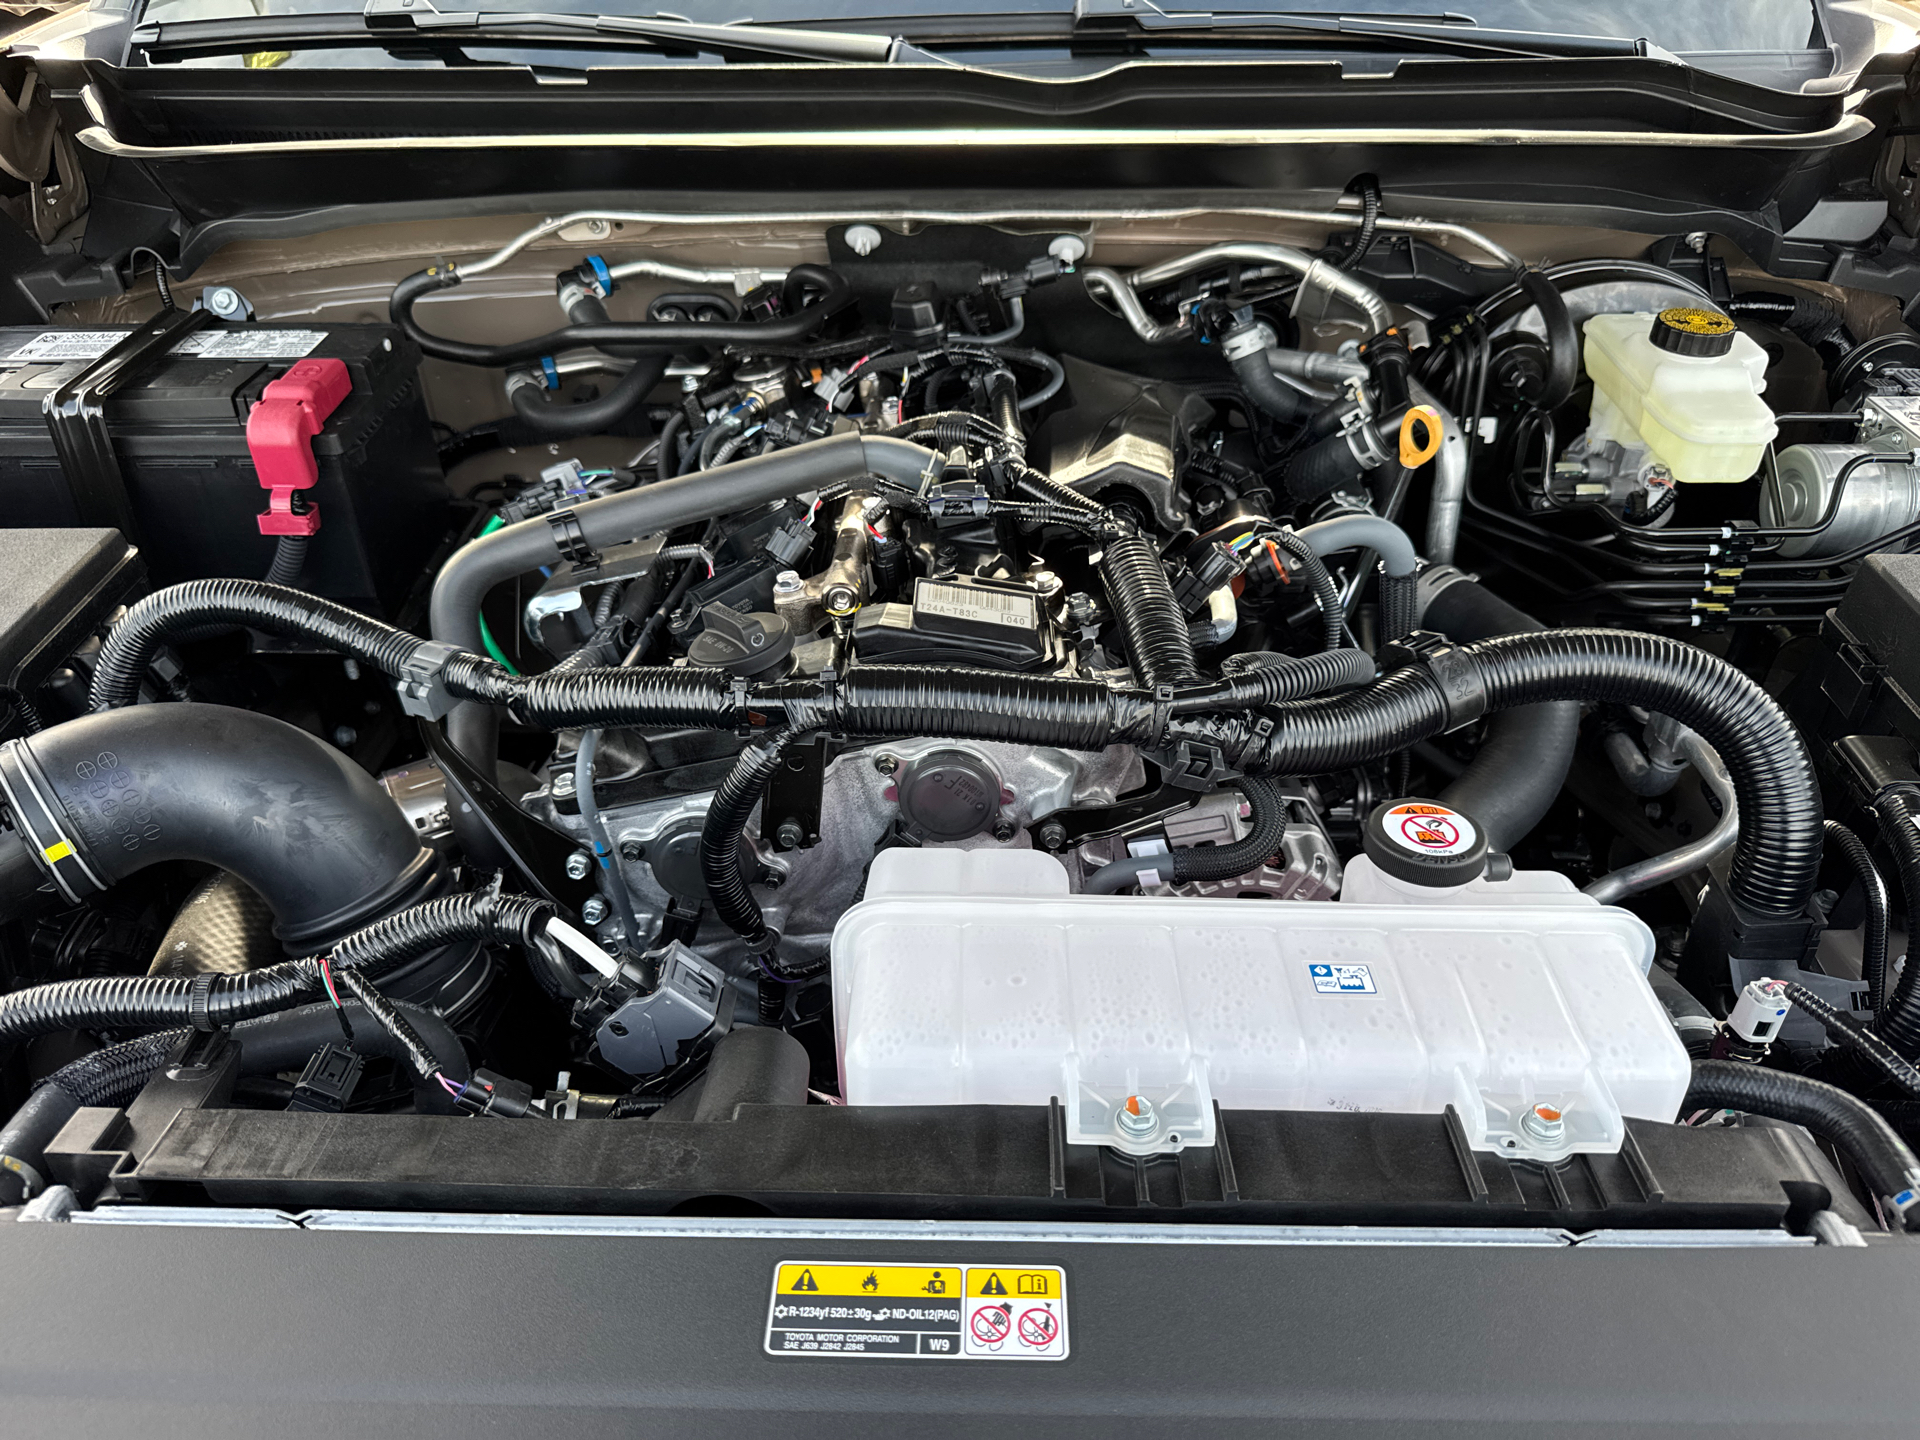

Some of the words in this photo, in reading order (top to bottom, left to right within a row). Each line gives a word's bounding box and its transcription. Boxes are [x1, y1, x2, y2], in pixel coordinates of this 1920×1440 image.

[920, 602, 978, 618] T24A-T83C
[1007, 615, 1025, 625] 040
[1412, 853, 1468, 865] DENSO
[788, 1306, 829, 1320] R-1234yf
[830, 1307, 872, 1321] 520±30g
[892, 1308, 960, 1323] ND-OIL12(PAG)
[785, 1333, 814, 1342] TOYOTA
[816, 1334, 844, 1343] MOTOR
[846, 1335, 900, 1344] CORPORATION
[929, 1338, 950, 1351] W9
[783, 1341, 799, 1350] SAE
[801, 1342, 818, 1350] J639
[820, 1342, 841, 1351] J2842
[843, 1343, 865, 1351] J2845
